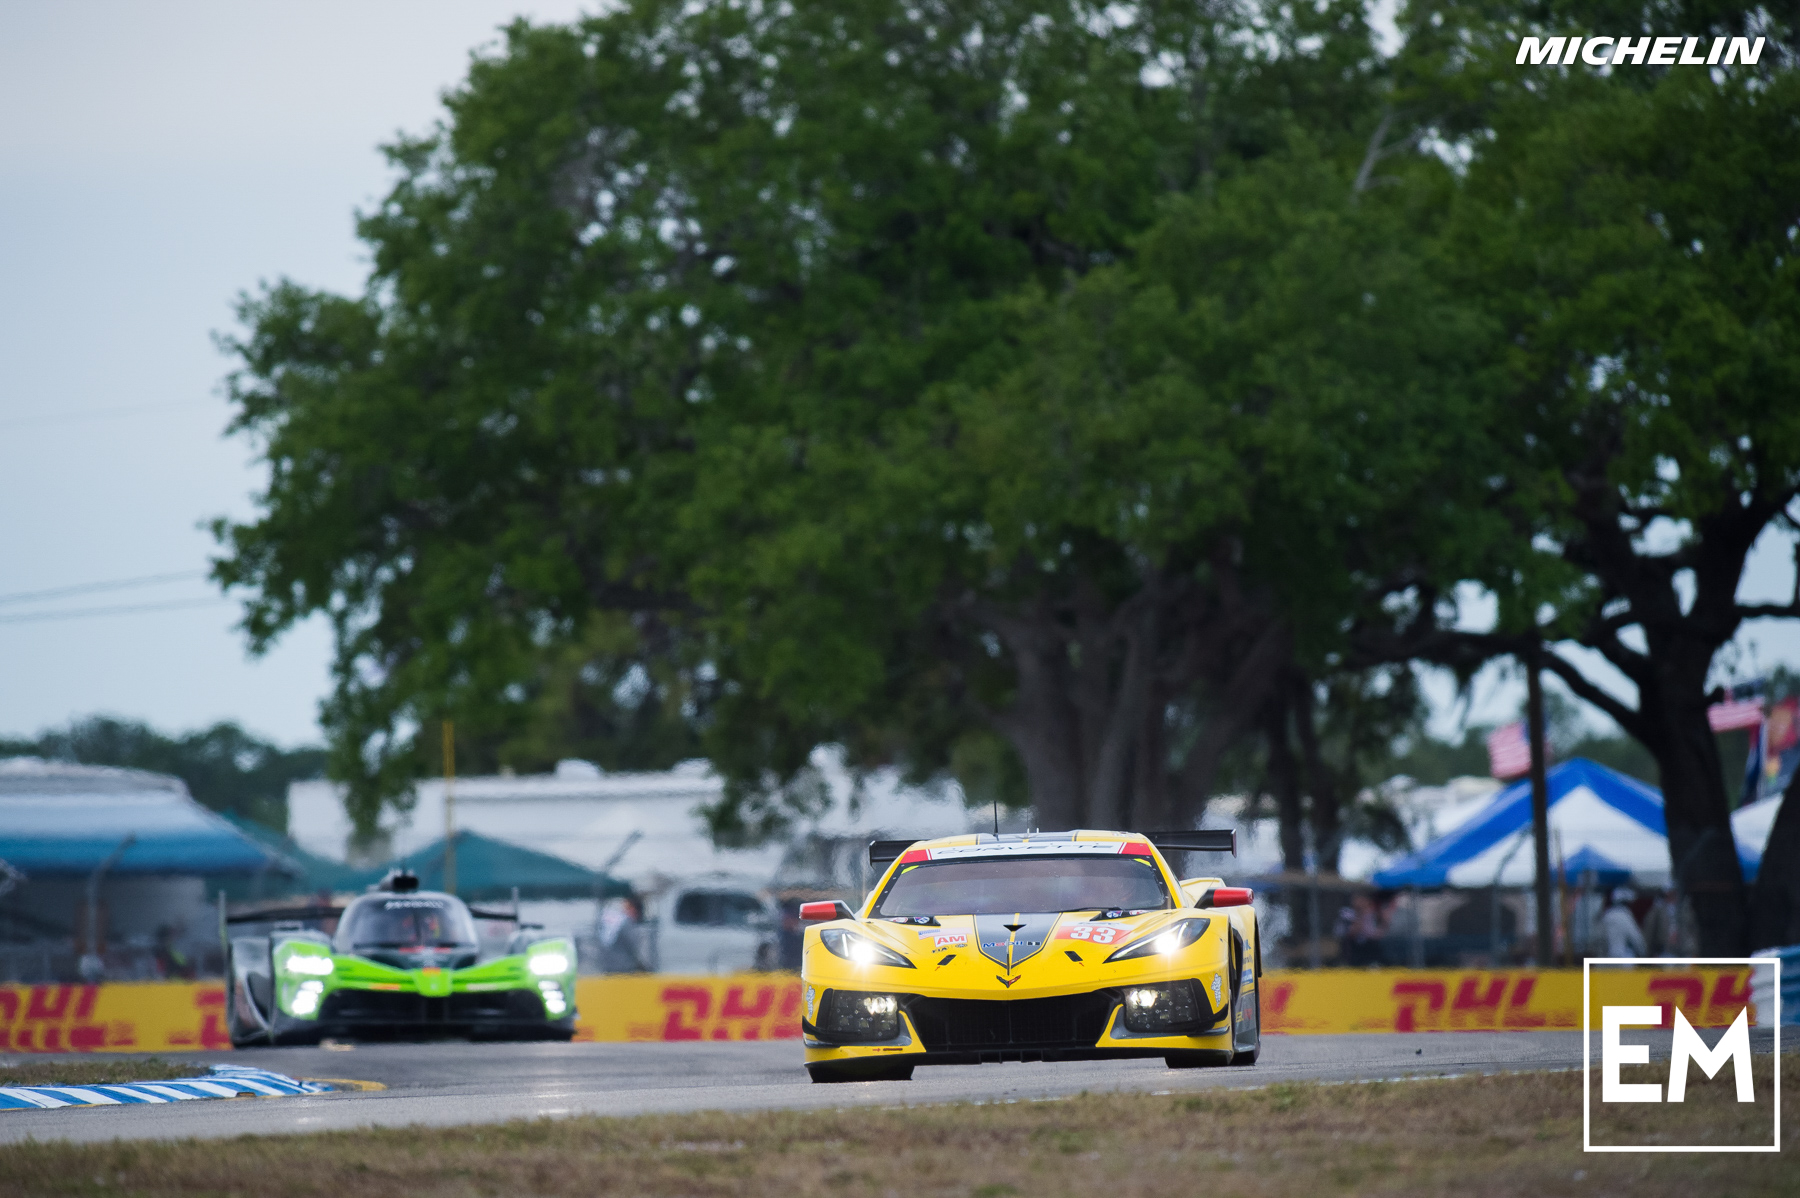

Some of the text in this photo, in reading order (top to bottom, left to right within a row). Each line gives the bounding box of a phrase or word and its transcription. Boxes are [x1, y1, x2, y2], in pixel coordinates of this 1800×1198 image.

[936, 935, 965, 945] AM
[1070, 926, 1116, 944] 33
[1392, 976, 1546, 1032] DHL
